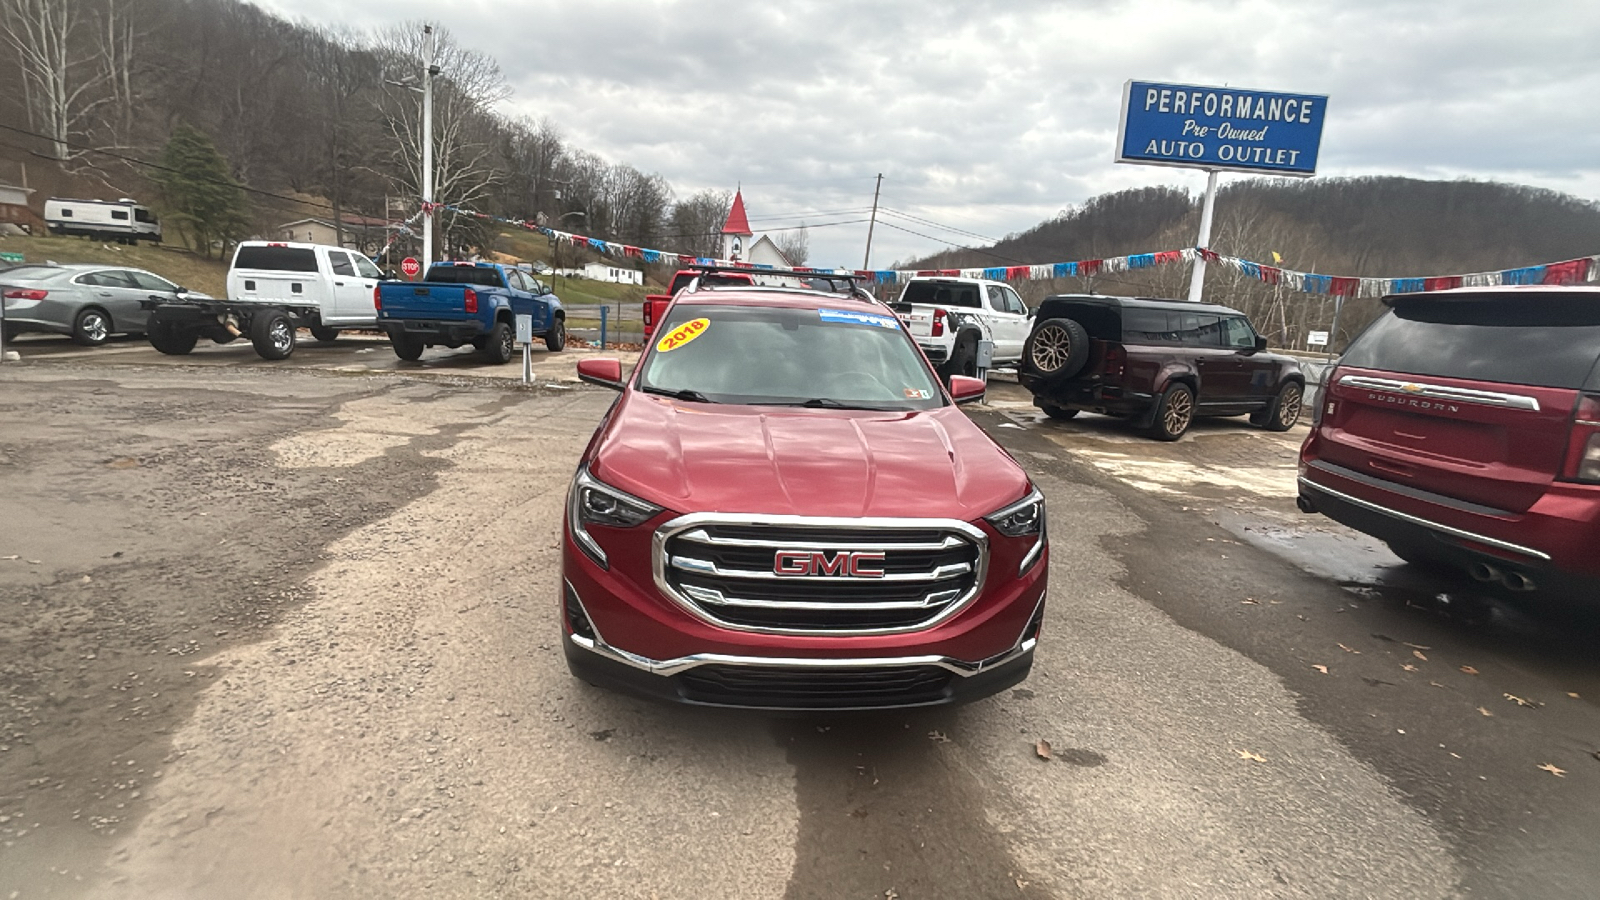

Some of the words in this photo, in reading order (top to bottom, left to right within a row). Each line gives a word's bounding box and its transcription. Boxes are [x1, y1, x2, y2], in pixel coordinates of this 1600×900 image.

[1145, 88, 1313, 124] PERFORMANCE
[1182, 119, 1269, 141] Pre-Owned
[1145, 139, 1204, 159] AUTO
[1218, 144, 1300, 166] OUTLET
[402, 262, 418, 271] STOP
[663, 321, 704, 349] 2018
[1368, 393, 1459, 412] SUBURBAN
[774, 550, 885, 577] GMC
